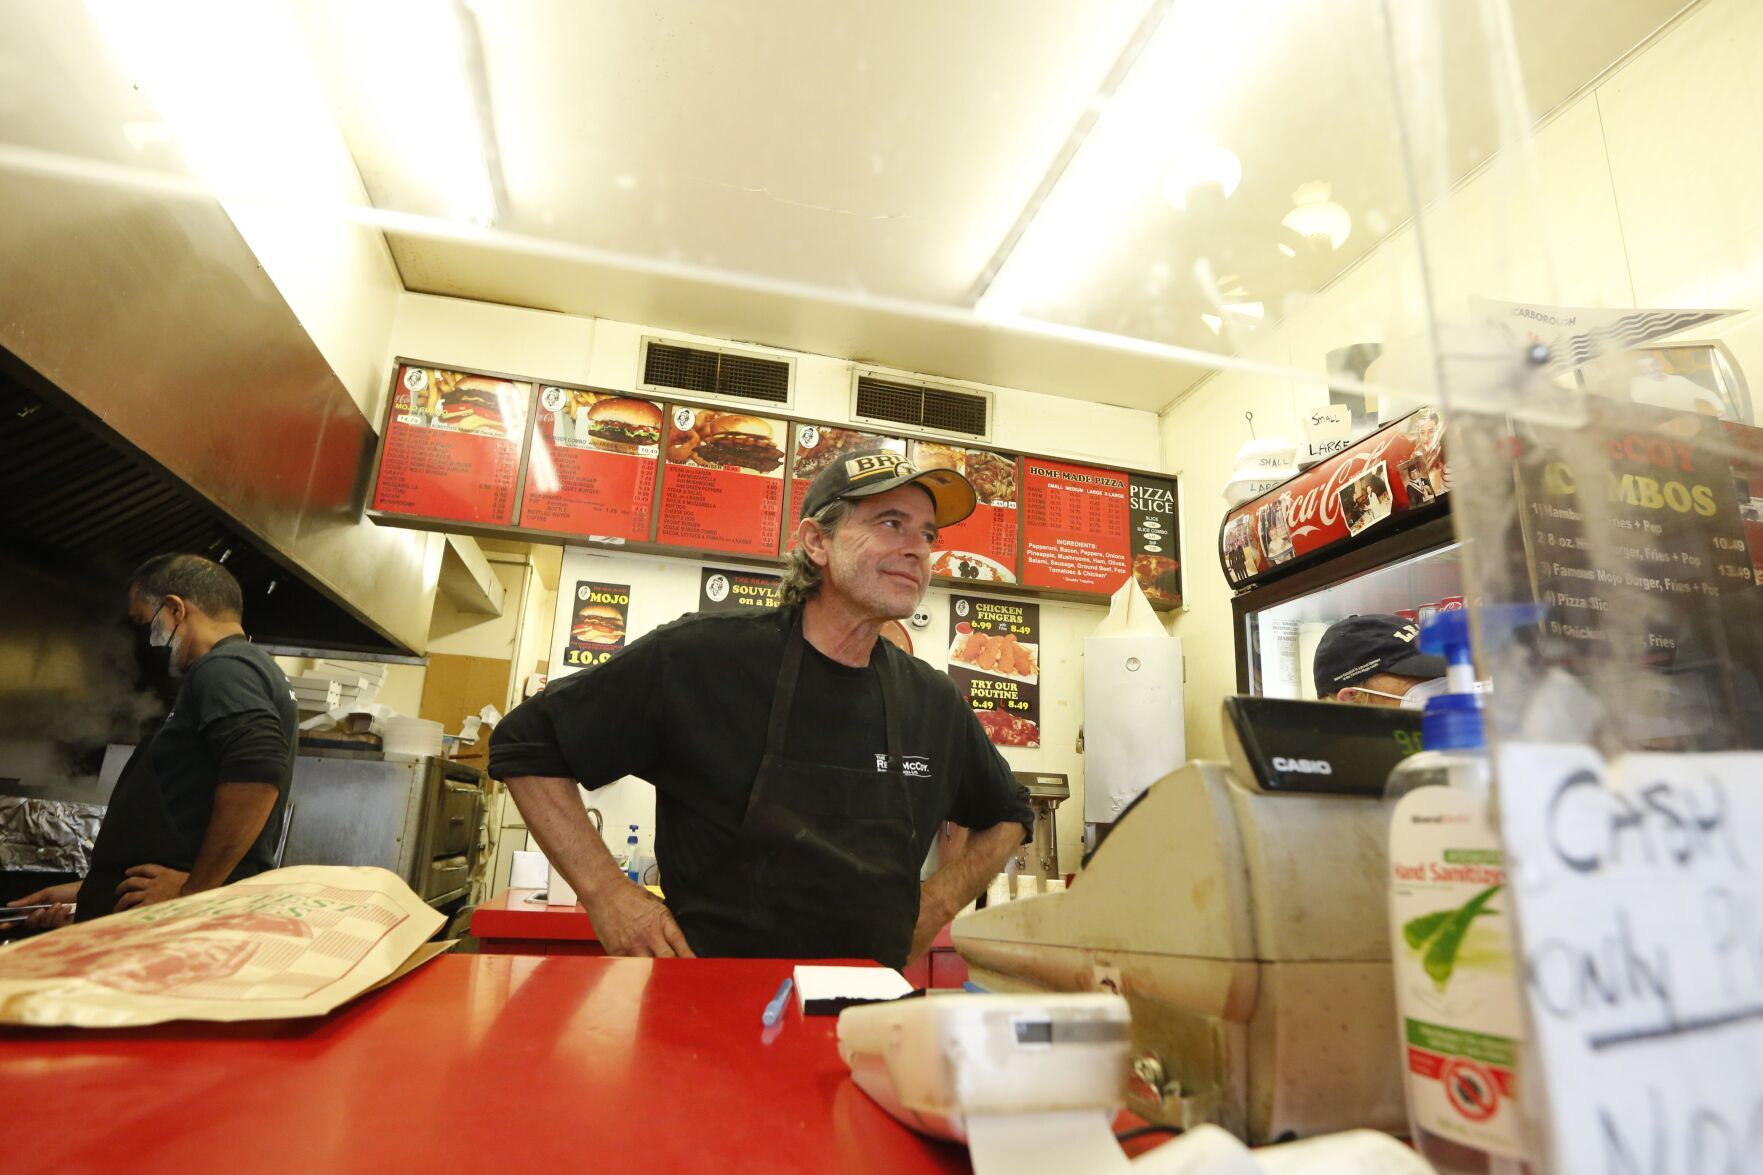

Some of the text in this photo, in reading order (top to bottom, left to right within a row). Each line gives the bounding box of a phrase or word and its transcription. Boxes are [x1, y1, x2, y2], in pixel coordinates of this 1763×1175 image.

[1030, 466, 1125, 488] HOME MADE PIZZA
[1130, 484, 1174, 502] PIZZA
[1543, 461, 1717, 516] CMBOS
[1130, 497, 1174, 514] SLICE
[1028, 542, 1058, 552] Pepperoni,
[1060, 546, 1078, 555] Bacon,
[1080, 549, 1105, 559] Peppers,
[1056, 539, 1098, 549] INGREDIENTS:
[1027, 550, 1057, 560] Pineapple,
[1058, 553, 1092, 563] Mushrooms,
[1048, 566, 1076, 575] Tomatoes
[1077, 563, 1098, 571] Ground
[1553, 564, 1594, 580] Famous
[1598, 569, 1623, 586] Mojo
[1664, 578, 1692, 593] Fries
[590, 592, 628, 604] MOJO
[1558, 593, 1586, 608] Pizza
[976, 604, 1023, 615] CHICKEN
[978, 612, 1023, 624] FINGERS
[972, 620, 992, 630] 6.99
[1010, 624, 1030, 634] 8.49
[1648, 634, 1676, 648] Fries
[970, 680, 1018, 691] TRY OUR
[970, 688, 1018, 700] POUTINE
[972, 700, 1028, 710] 6.49 8.49
[1272, 756, 1332, 776] CASIO
